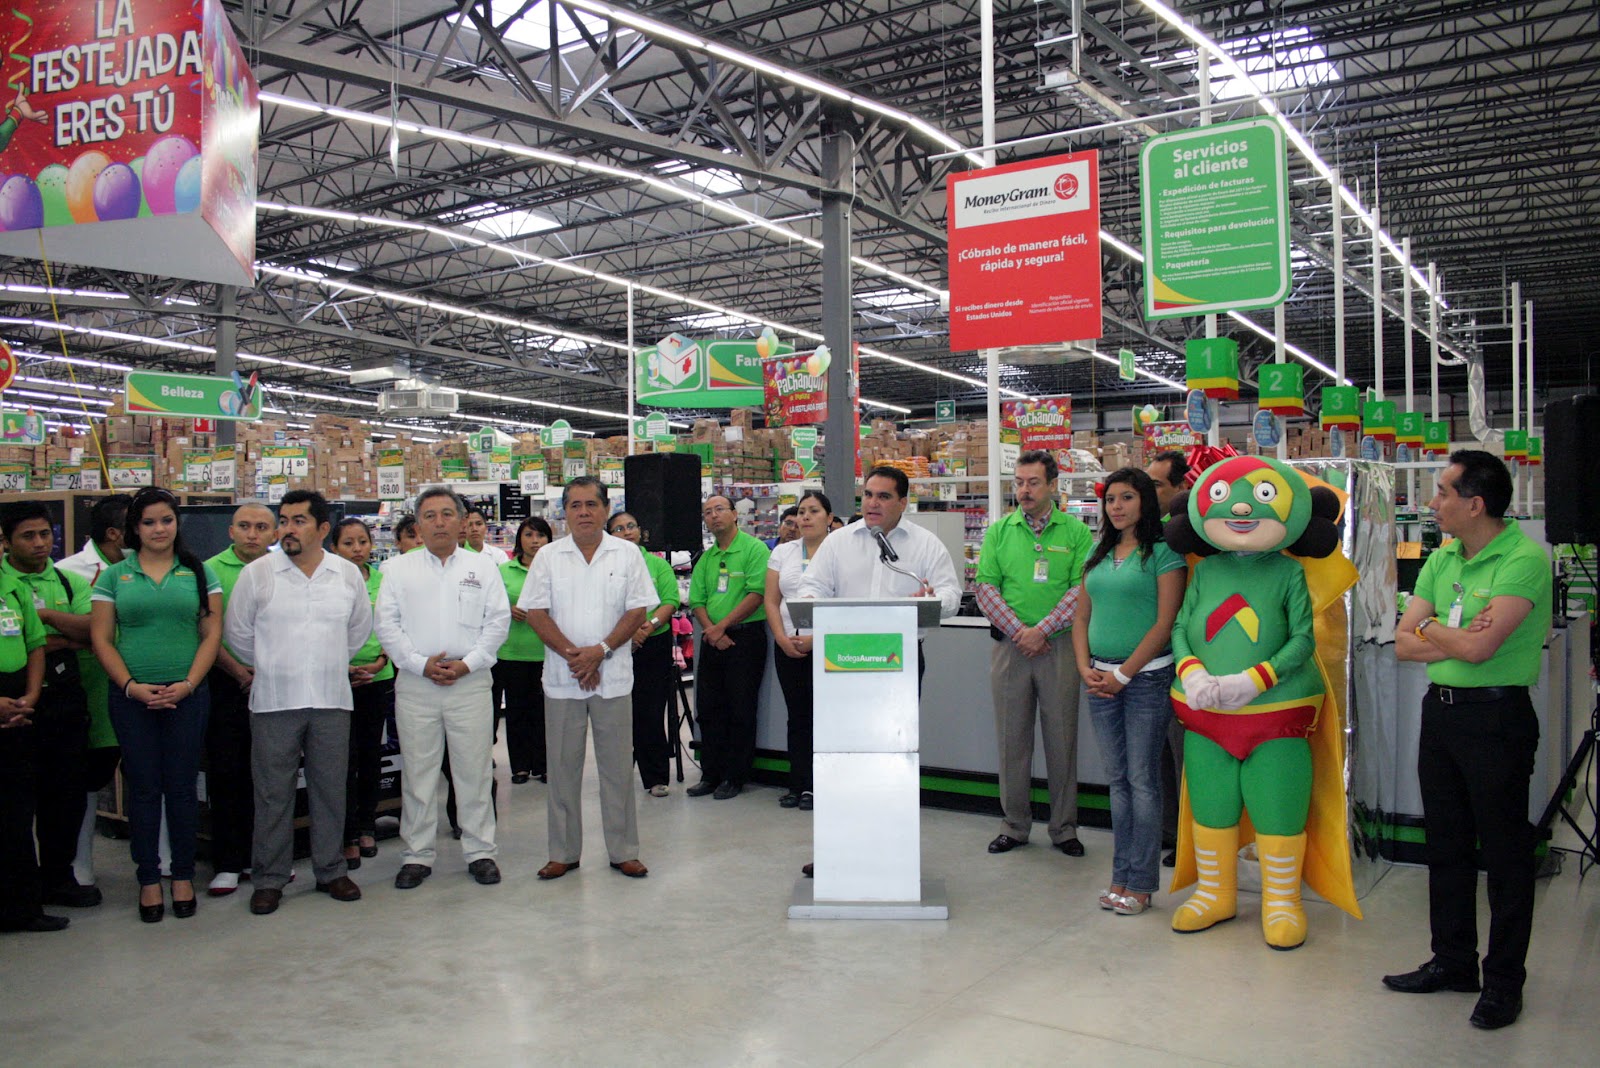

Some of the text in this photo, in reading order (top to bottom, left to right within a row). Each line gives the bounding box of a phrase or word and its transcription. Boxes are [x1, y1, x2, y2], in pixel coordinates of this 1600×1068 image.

[96, 0, 135, 38] LA
[32, 30, 203, 93] FESTEJADA
[56, 84, 175, 146] ERES TÚ
[1173, 140, 1248, 163] Servicios
[1174, 156, 1248, 179] al cliente
[1162, 176, 1254, 198] Expedición de facturas
[964, 186, 1048, 209] MoneyGram
[1164, 216, 1275, 240] Requisitos para devolución
[958, 233, 1088, 263] ¡Cóbralo de manera fácil,
[980, 251, 1064, 272] rápida y segura!
[1165, 257, 1210, 272] Paquetería
[955, 298, 1024, 313] Si recibes dinero desde
[966, 309, 1012, 321] Estados Unidos
[1201, 346, 1212, 370] 1
[1269, 371, 1283, 391] 2
[161, 385, 204, 399] Belleza
[1331, 392, 1343, 410] 3
[1372, 407, 1384, 422] 4
[1403, 417, 1413, 431] 5
[544, 432, 549, 442] 7
[638, 425, 644, 435] 8
[1429, 426, 1439, 440] 6
[472, 438, 478, 447] 6
[1511, 434, 1519, 446] 7
